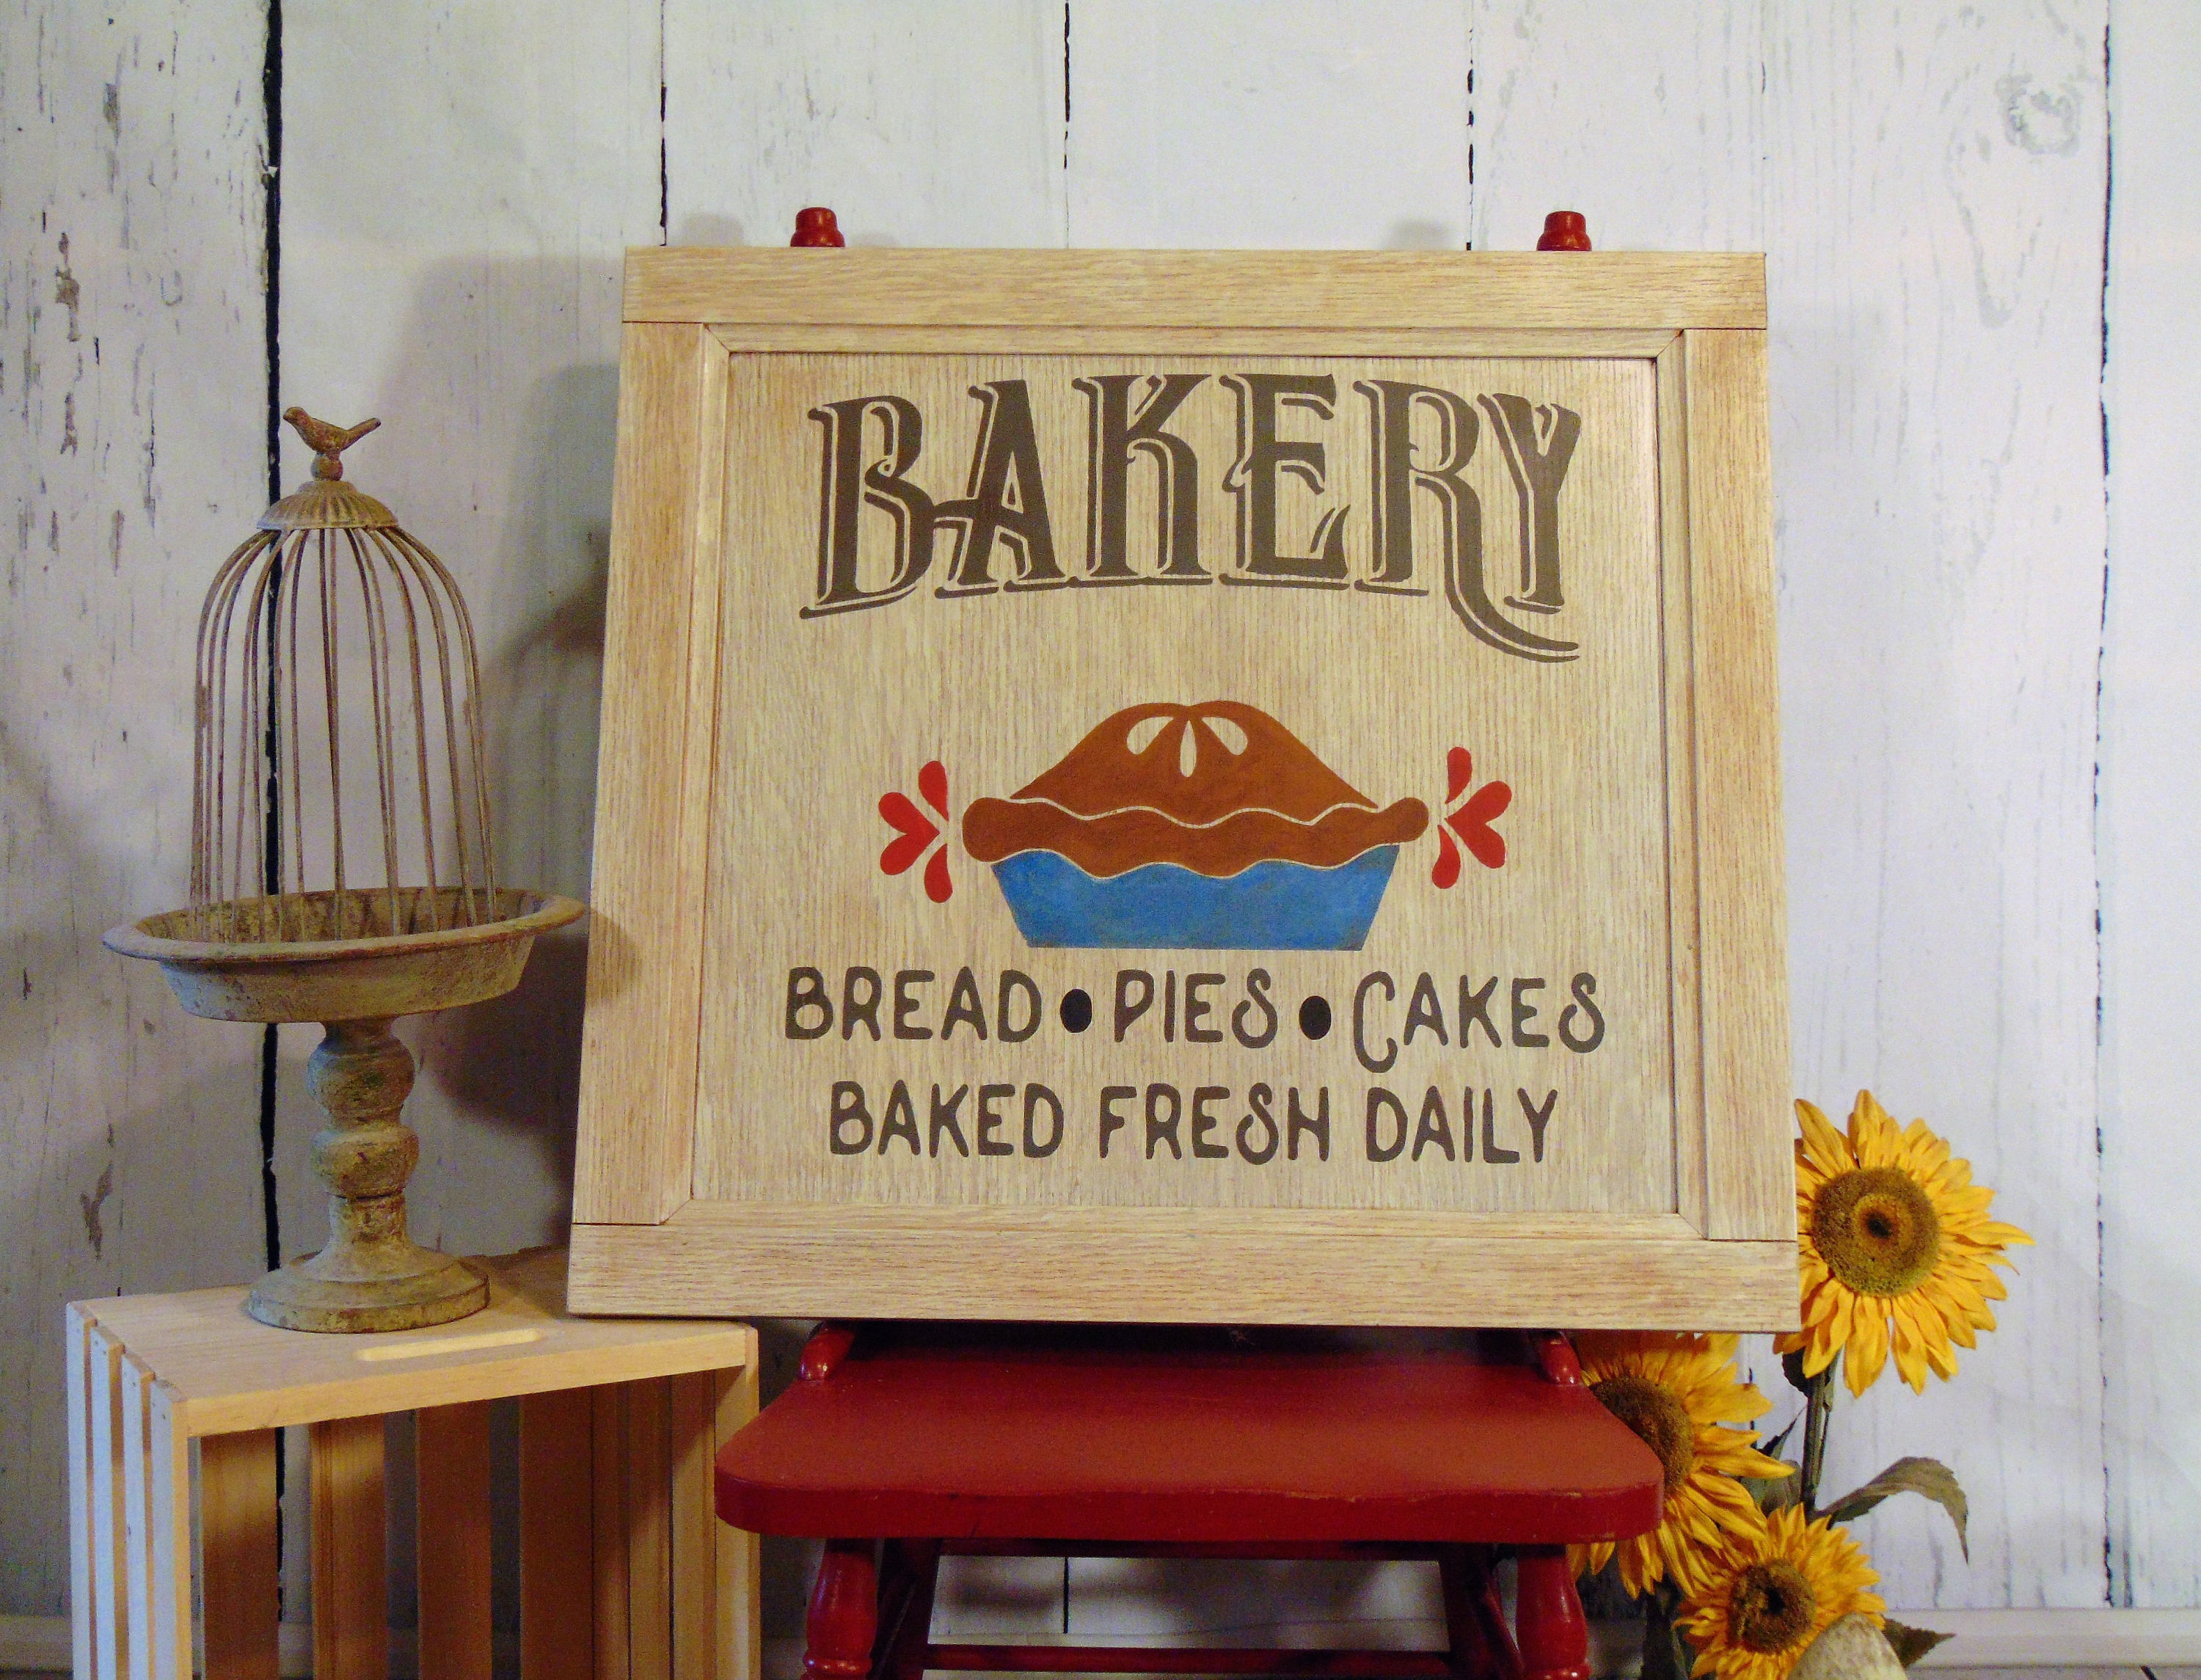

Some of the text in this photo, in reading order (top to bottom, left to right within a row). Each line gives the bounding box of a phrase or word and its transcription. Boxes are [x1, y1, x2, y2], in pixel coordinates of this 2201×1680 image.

[800, 373, 1582, 663] BAKERY
[784, 965, 1606, 1074] BREAD PIES CAKES
[829, 1079, 1559, 1166] BAKED FRESH DAILY
